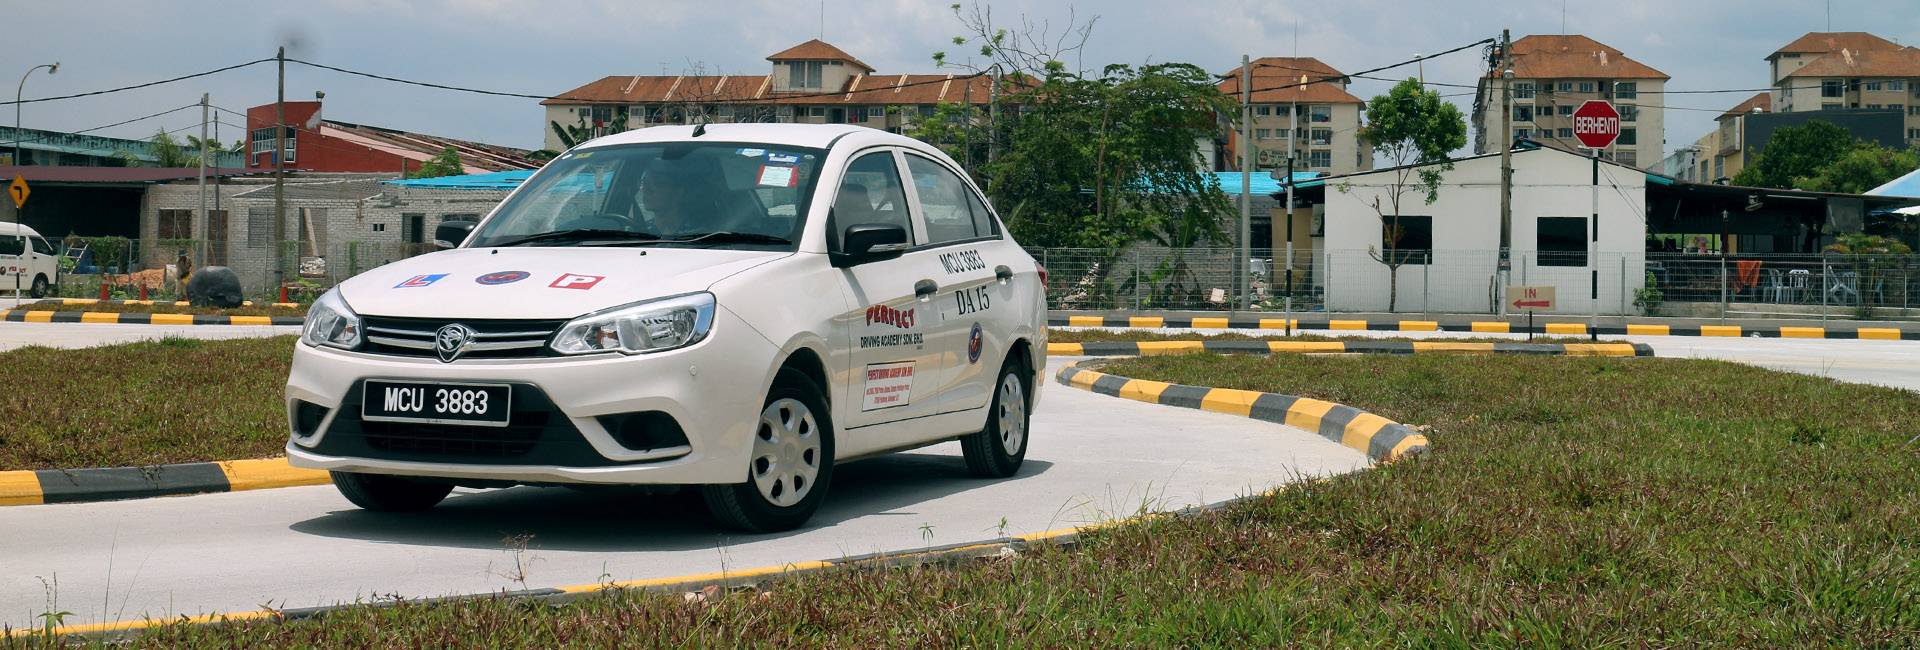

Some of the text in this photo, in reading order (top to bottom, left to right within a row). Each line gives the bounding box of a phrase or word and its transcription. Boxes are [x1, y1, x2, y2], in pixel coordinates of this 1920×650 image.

[1576, 116, 1618, 134] BERHENTI
[939, 249, 985, 275] MCU 3883
[556, 274, 597, 287] P
[955, 286, 990, 315] DA 15
[1524, 288, 1537, 298] IN
[866, 304, 915, 329] PERFECT
[860, 336, 880, 348] DRIVING
[880, 335, 902, 347] ACADEMY
[384, 387, 489, 415] MCU 3883
